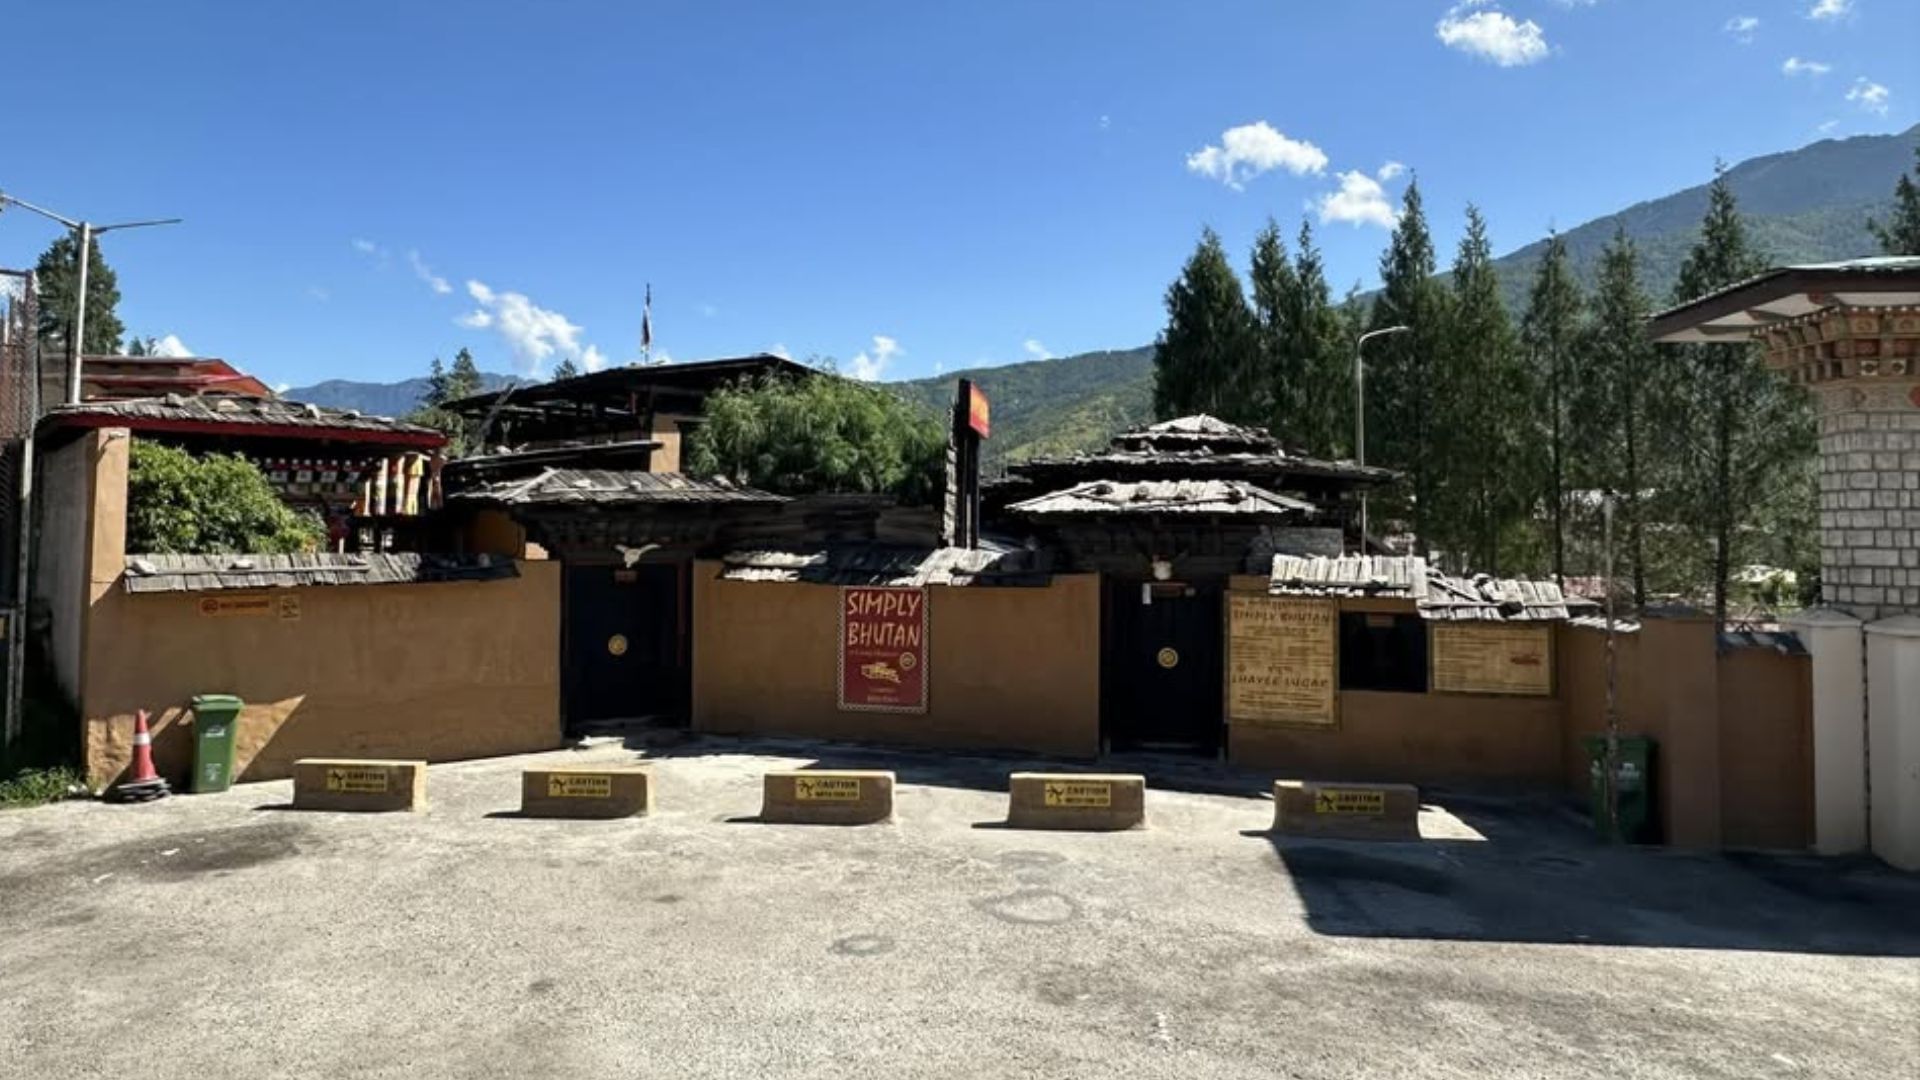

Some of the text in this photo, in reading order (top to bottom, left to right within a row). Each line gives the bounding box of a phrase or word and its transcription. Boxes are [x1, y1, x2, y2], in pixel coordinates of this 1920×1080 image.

[847, 591, 921, 617] SIMPLY
[1281, 612, 1330, 623] BHUTAN
[847, 621, 920, 648] BHUTAN
[346, 771, 385, 780] CAUTION
[568, 778, 608, 787] CAUTION
[816, 780, 857, 789] CAUTION
[1067, 786, 1107, 796] CAUTION
[1339, 794, 1380, 803] CAUTION
